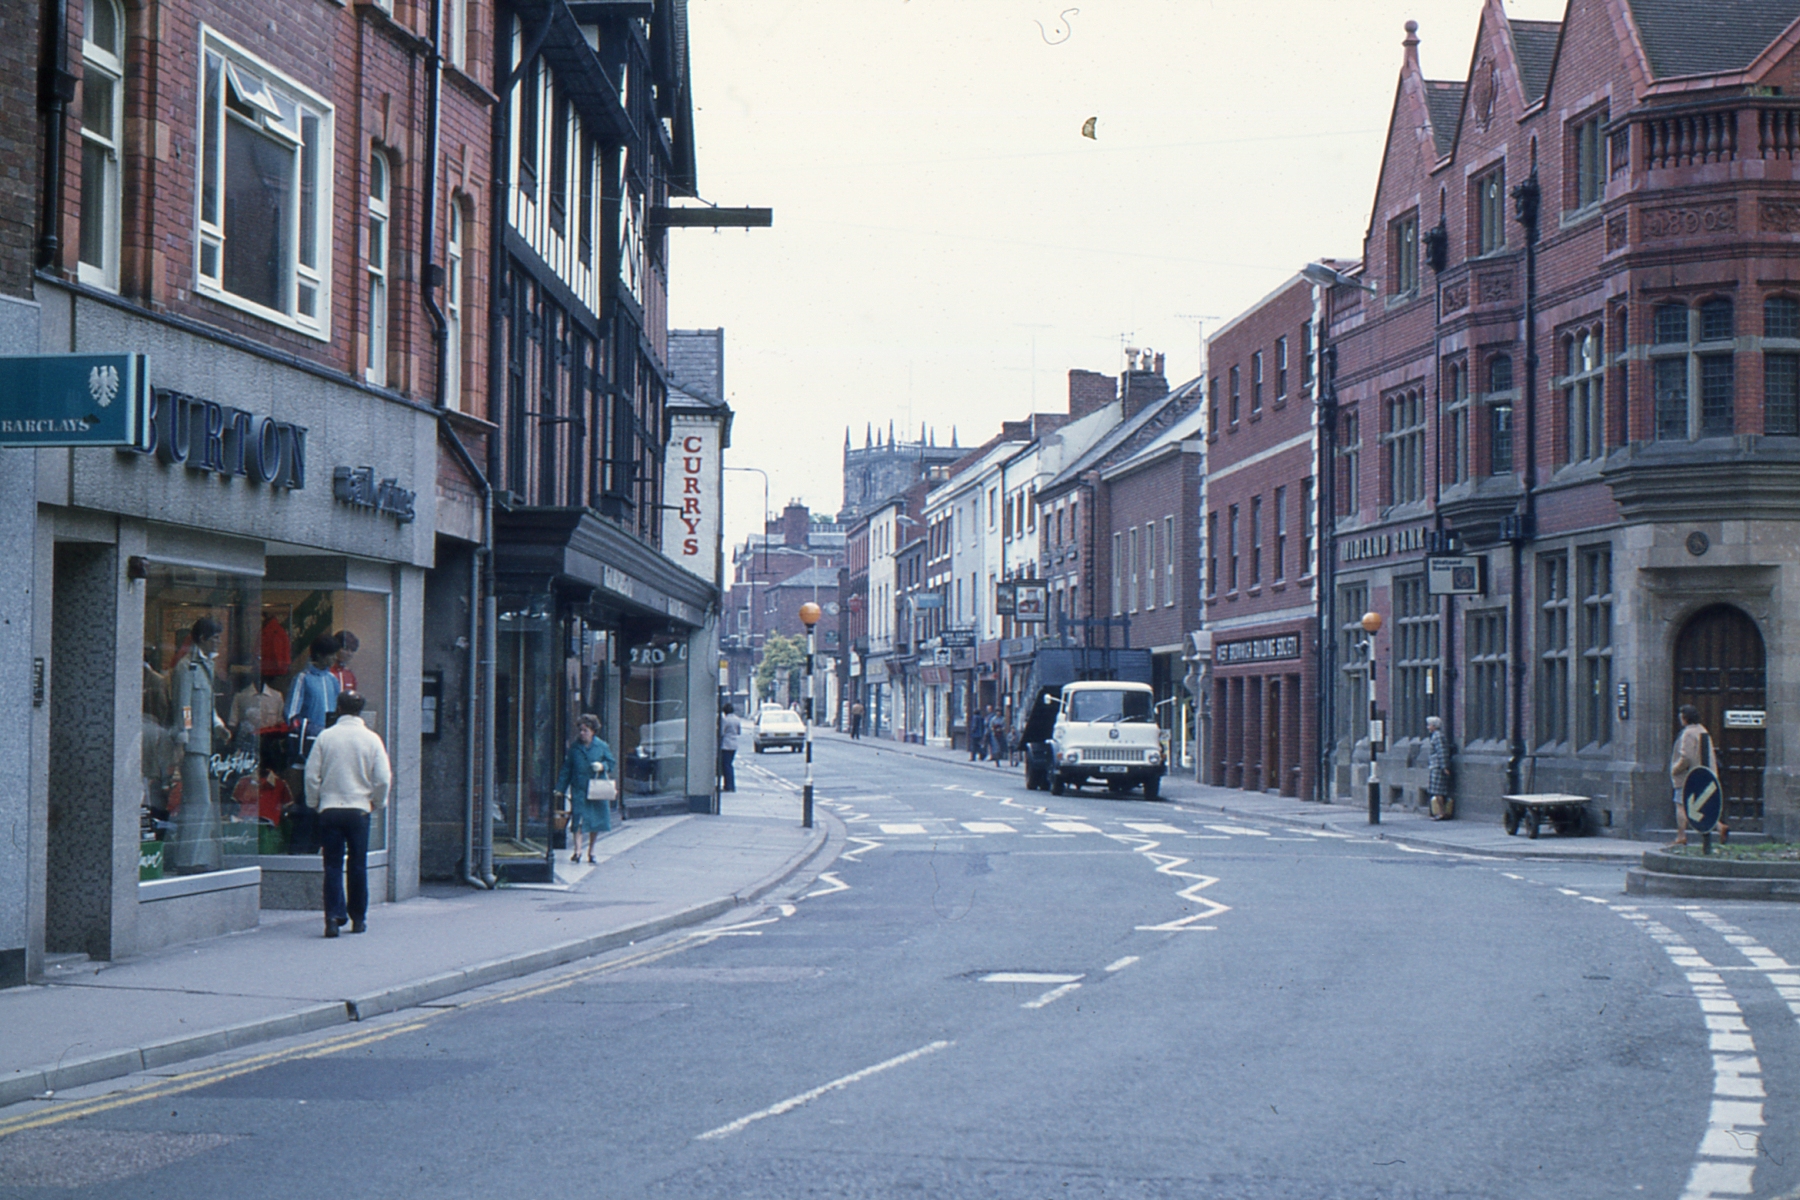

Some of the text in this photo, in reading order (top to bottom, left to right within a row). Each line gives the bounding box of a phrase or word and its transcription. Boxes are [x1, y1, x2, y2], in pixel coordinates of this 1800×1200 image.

[1657, 210, 1716, 235] 1890
[2, 418, 91, 432] BARCLAYS
[683, 436, 702, 555] CURRYS
[1340, 526, 1425, 562] MIDLAND BANK
